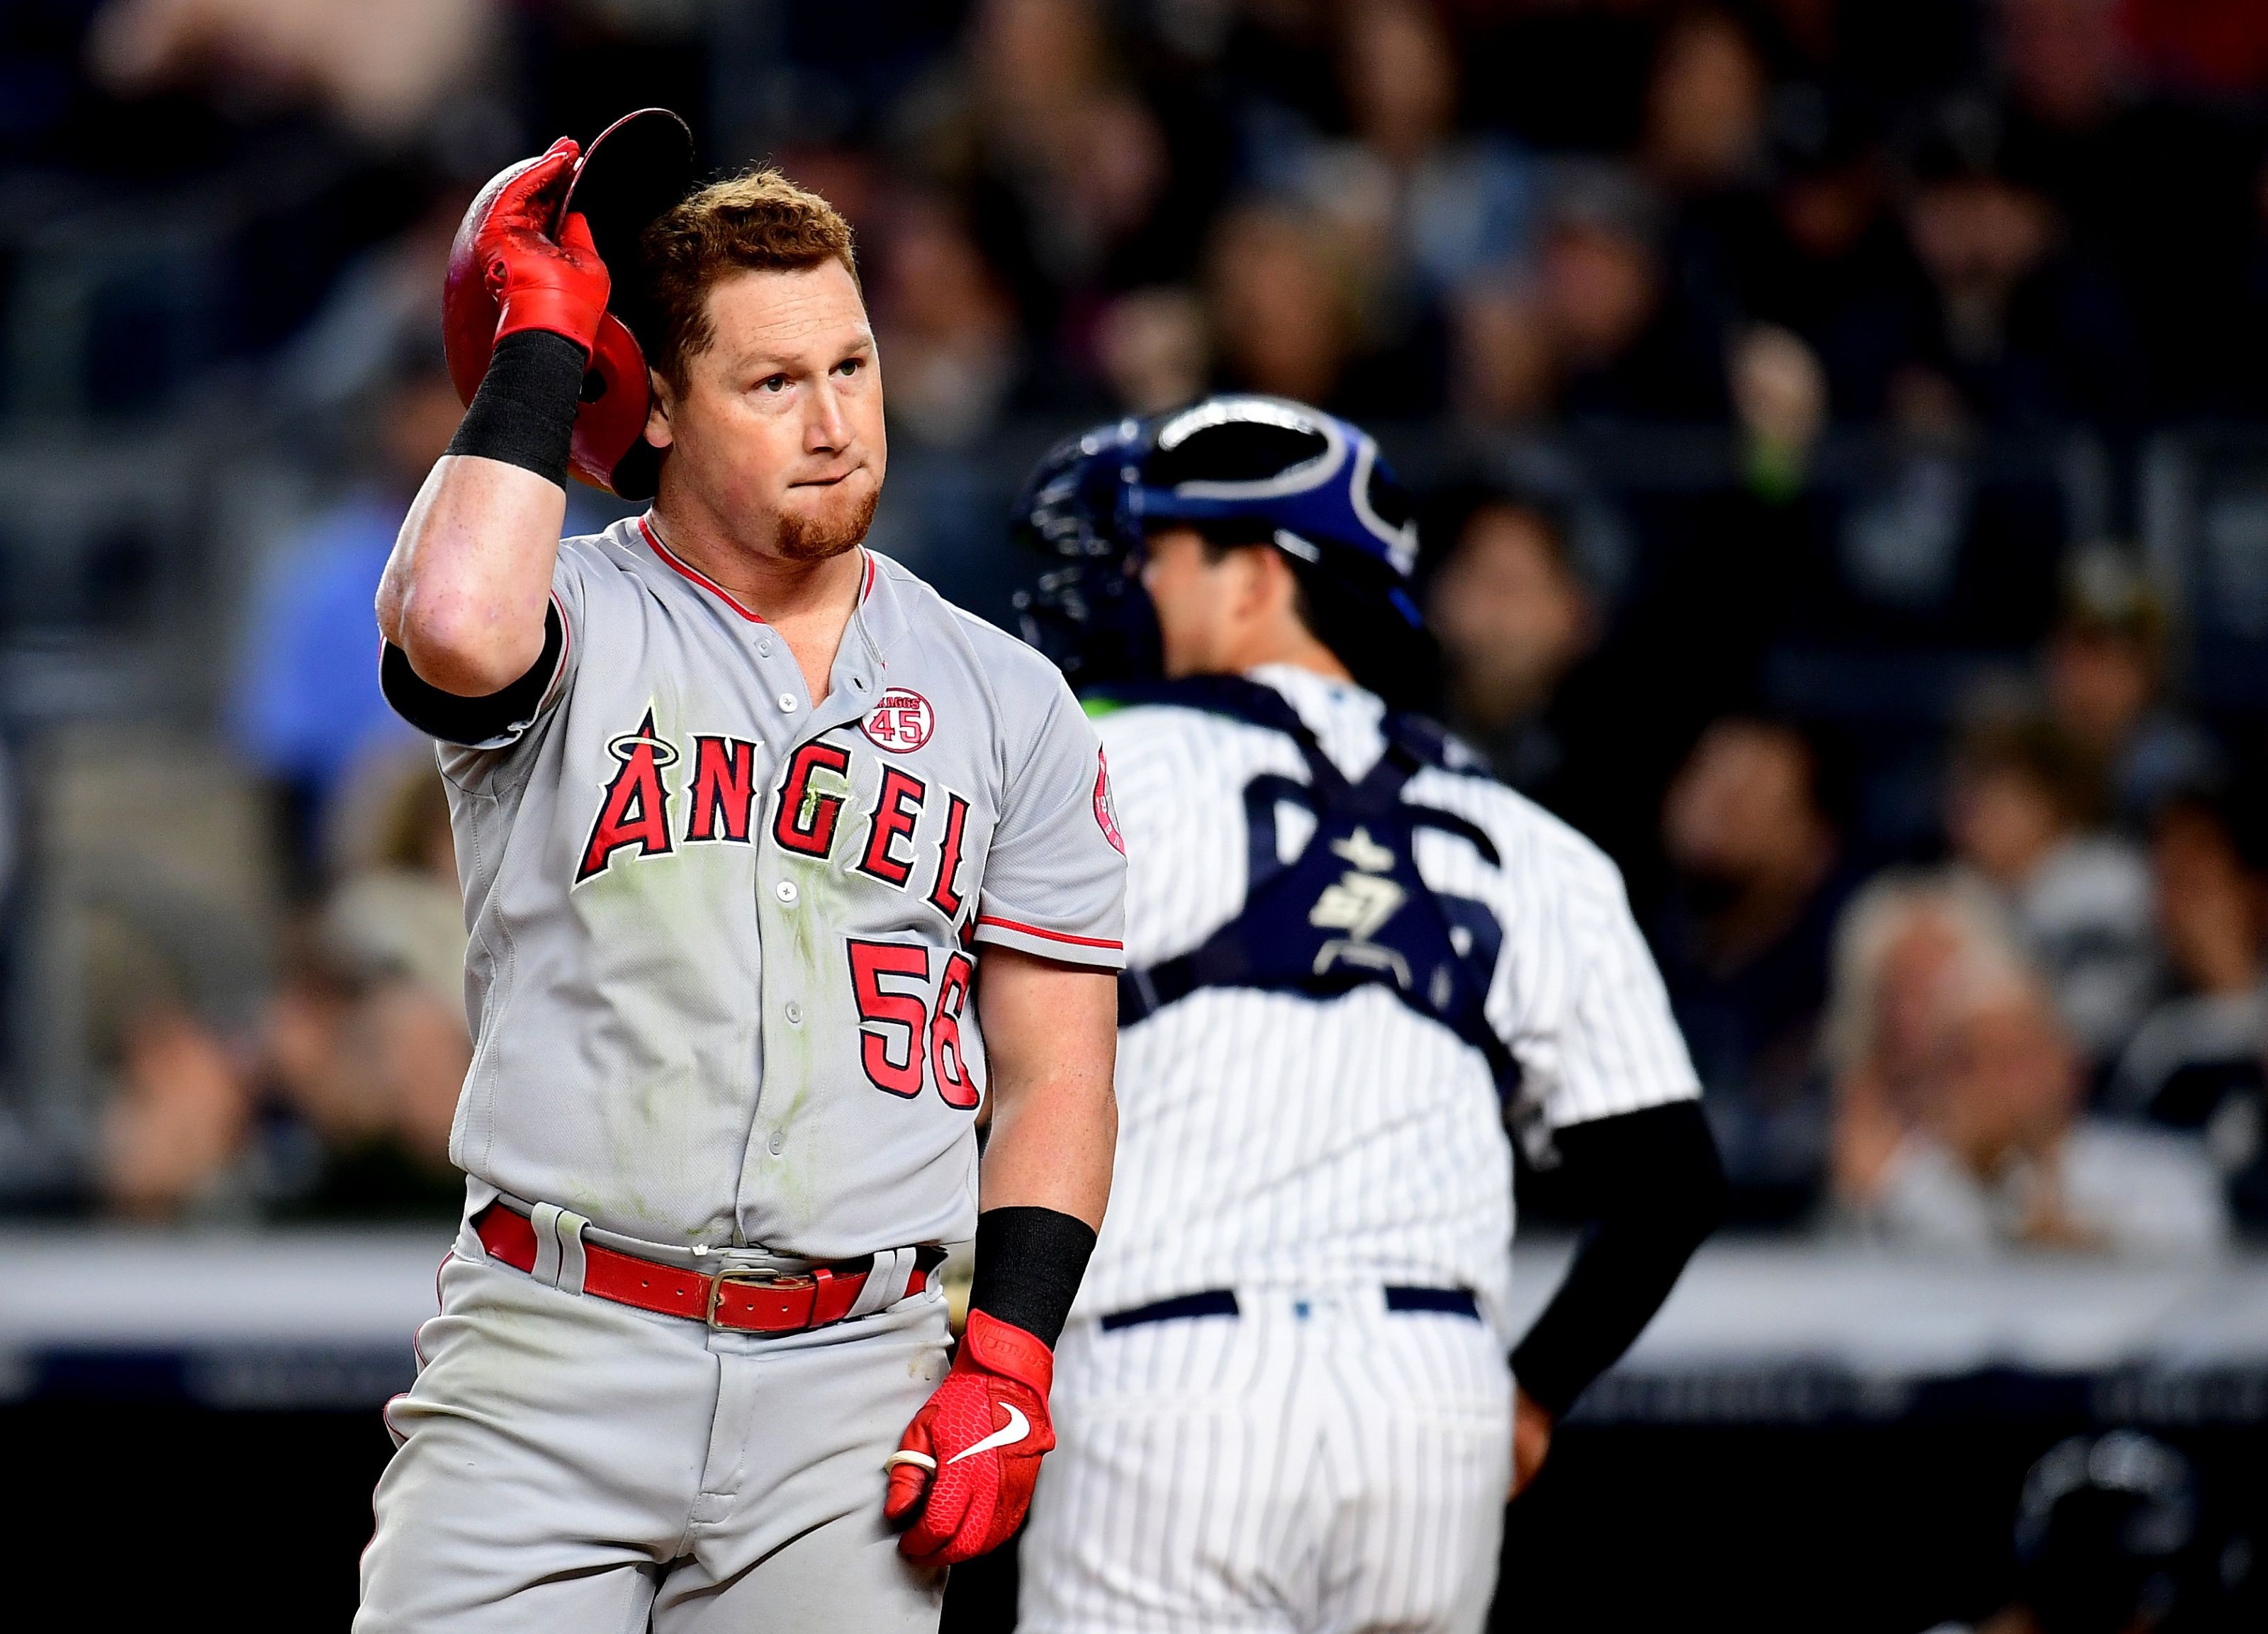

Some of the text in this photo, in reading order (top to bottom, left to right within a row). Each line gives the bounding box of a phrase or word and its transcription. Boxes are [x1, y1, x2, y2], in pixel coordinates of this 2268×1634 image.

[869, 709, 923, 744] 45
[873, 697, 921, 710] KAGGS
[571, 694, 977, 951] ANGEL
[846, 937, 981, 1110] 56
